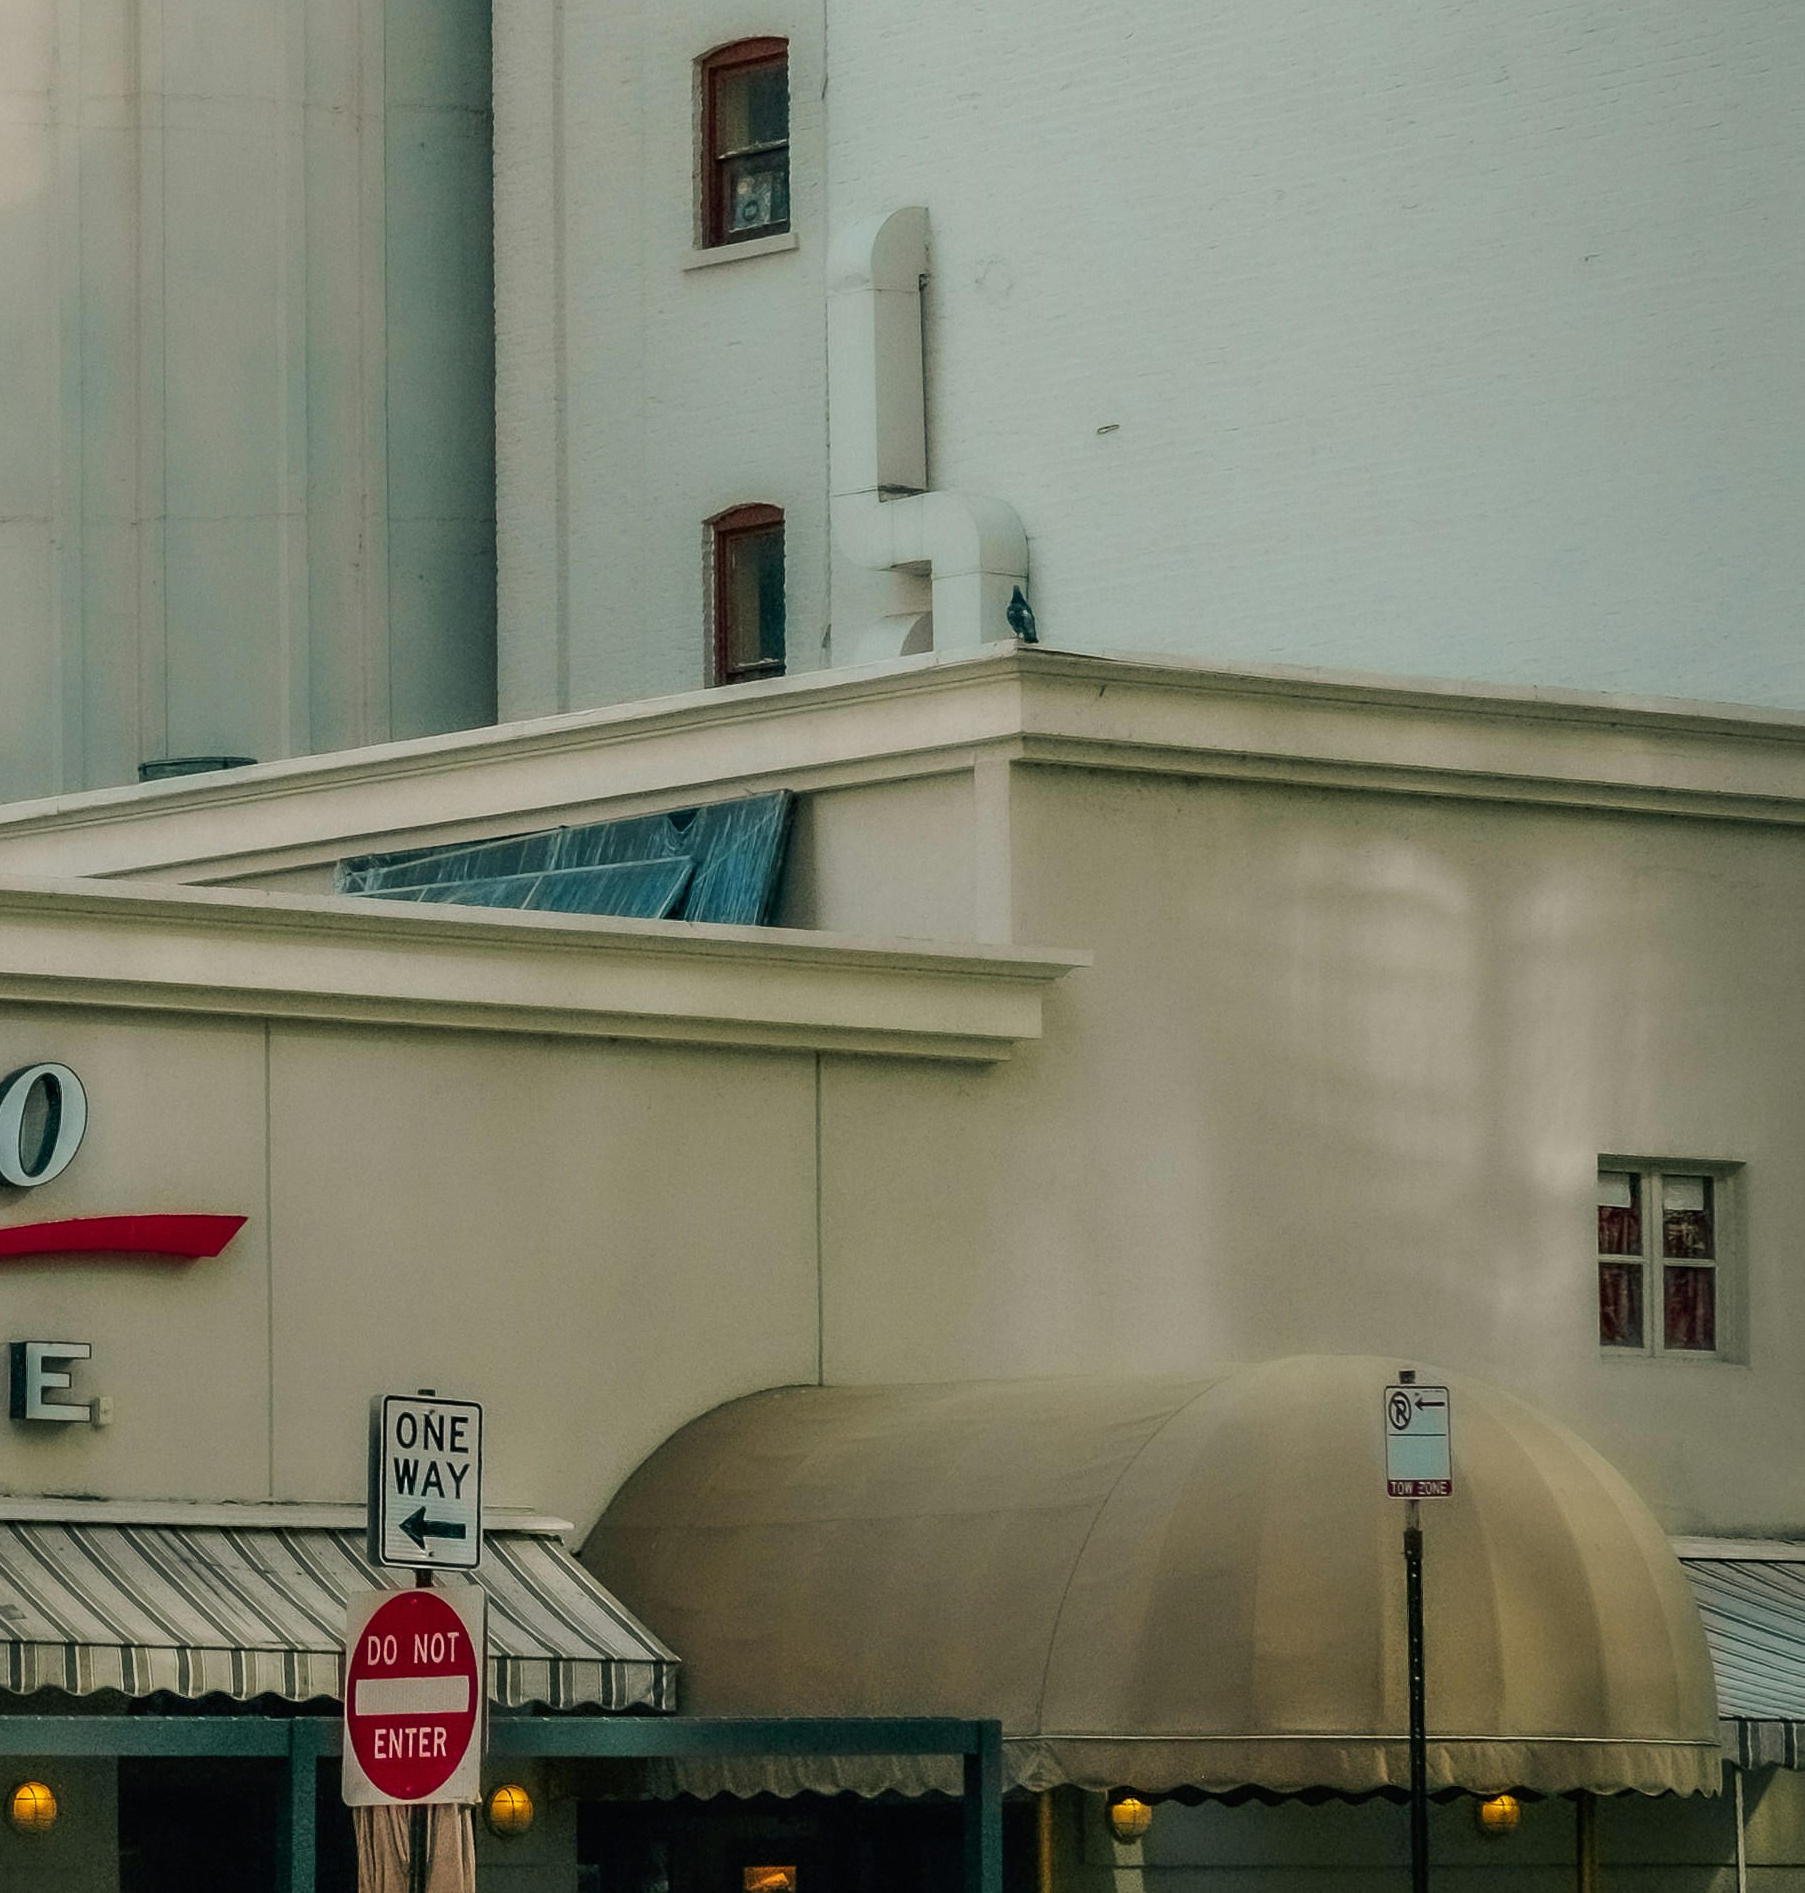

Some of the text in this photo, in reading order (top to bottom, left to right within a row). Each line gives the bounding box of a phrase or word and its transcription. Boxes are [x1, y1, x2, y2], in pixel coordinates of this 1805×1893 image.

[395, 1411, 470, 1454] ONE
[393, 1457, 470, 1499] WAY
[1390, 1481, 1448, 1495] TOW ZONE
[367, 1631, 460, 1666] DO NOT
[374, 1727, 447, 1759] ENTER
